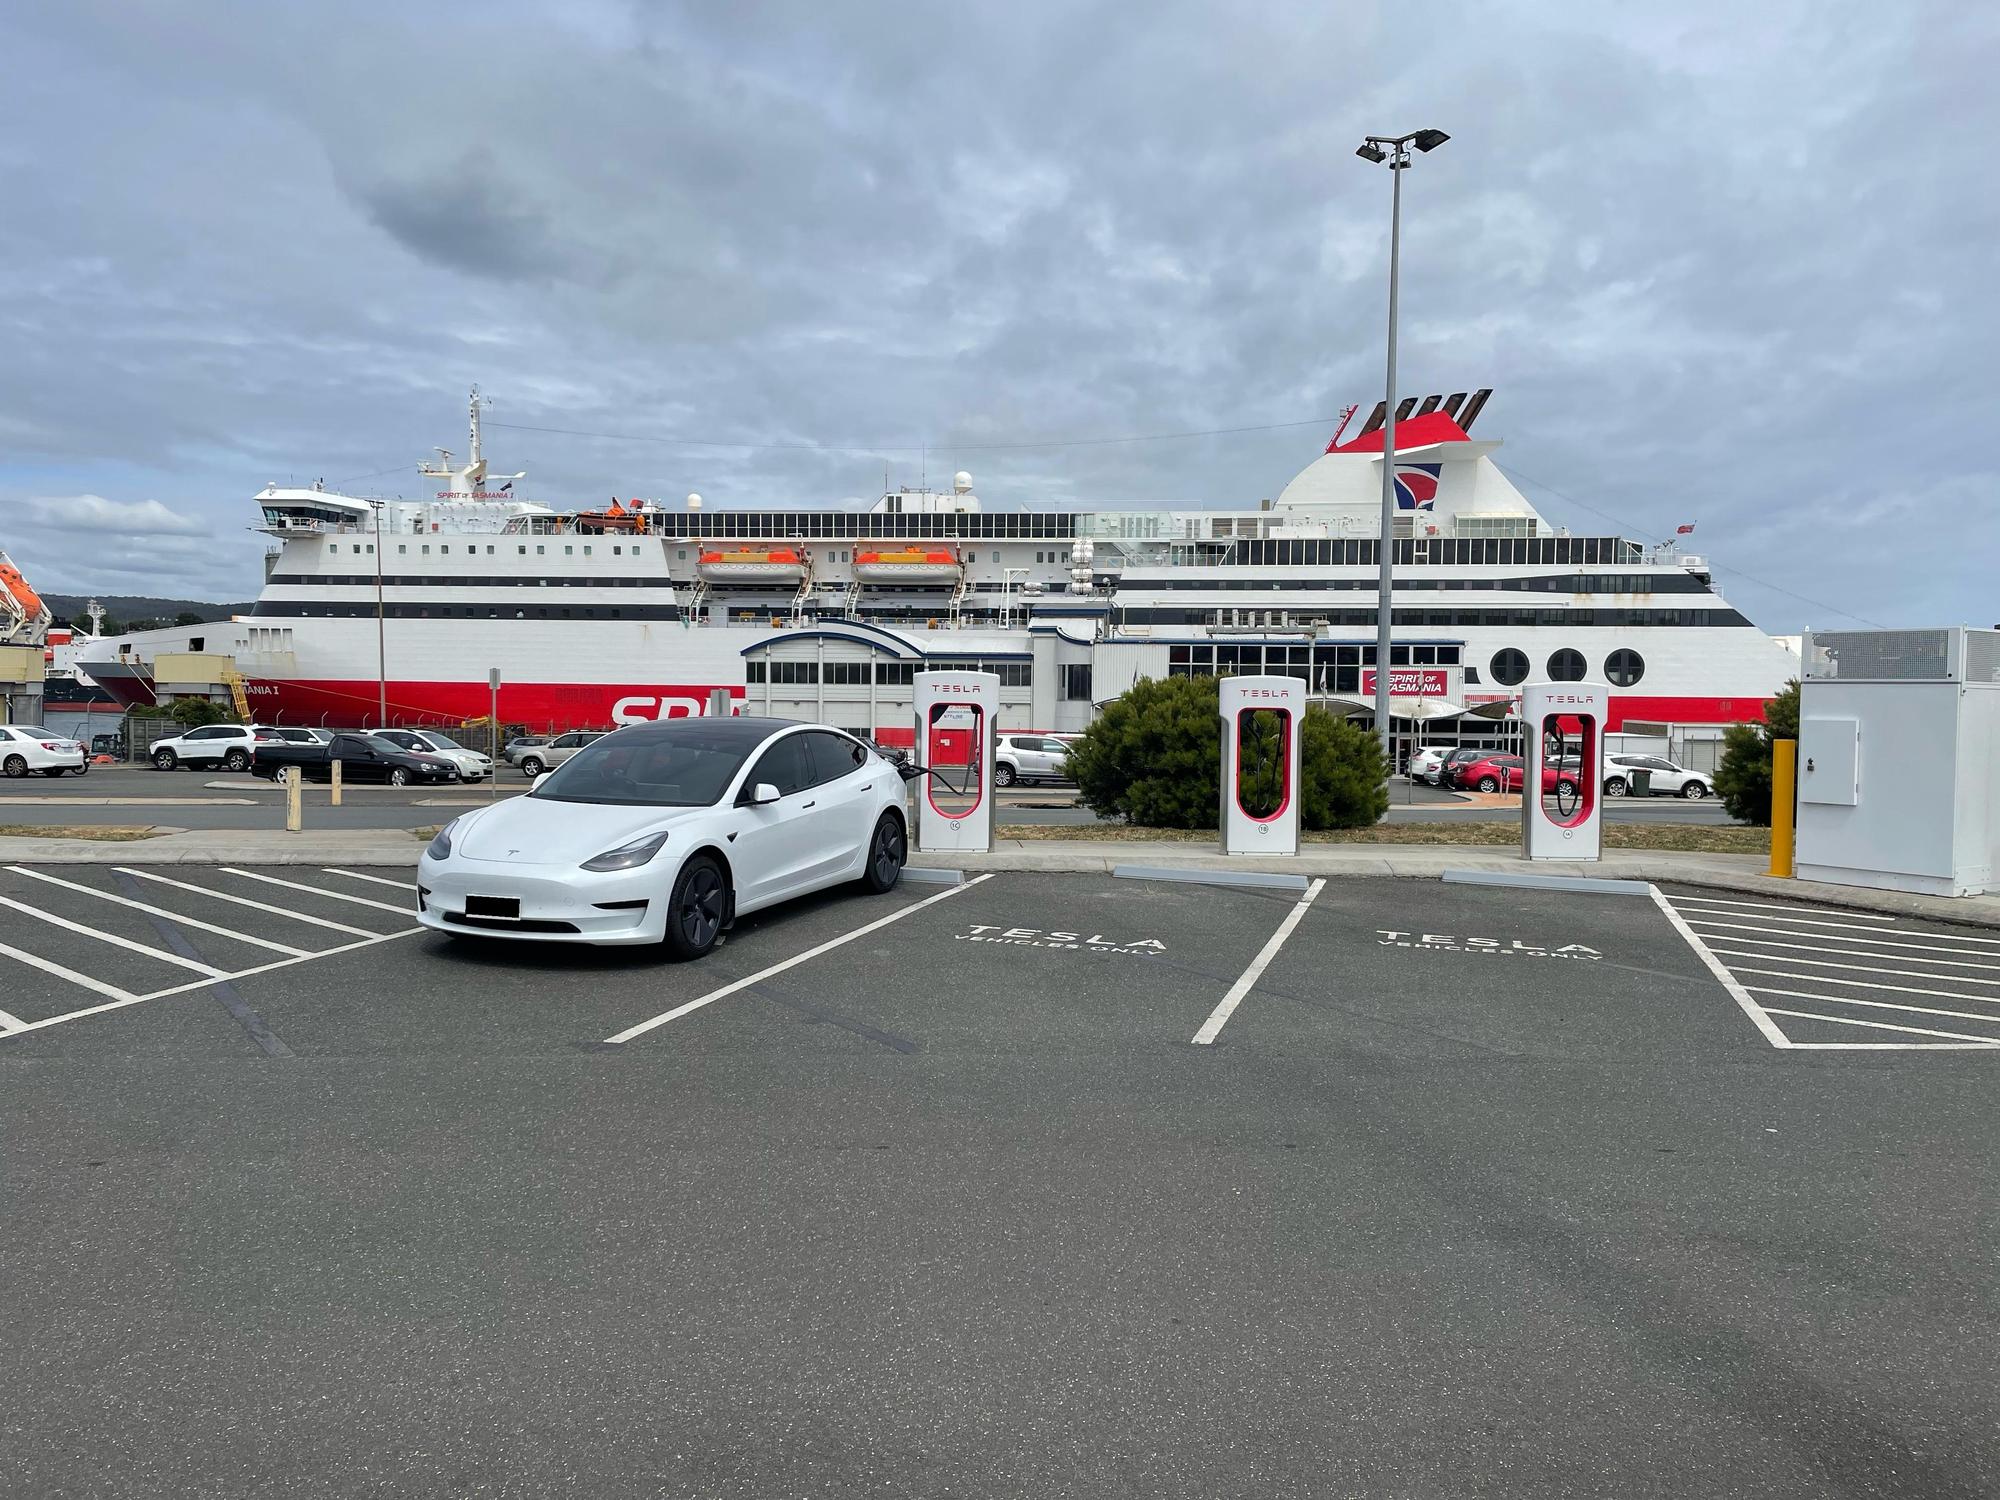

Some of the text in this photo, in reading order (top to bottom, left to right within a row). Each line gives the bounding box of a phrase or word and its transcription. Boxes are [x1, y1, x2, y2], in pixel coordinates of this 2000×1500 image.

[932, 684, 981, 693] TESLA
[1240, 689, 1289, 698] TESLA
[1546, 695, 1594, 704] TESLA
[954, 934, 1163, 955] VEHICLES ONLY
[969, 924, 1167, 950] TESLA
[1376, 929, 1602, 954] TESLA
[1377, 940, 1603, 960] VEHICLES ONLY
